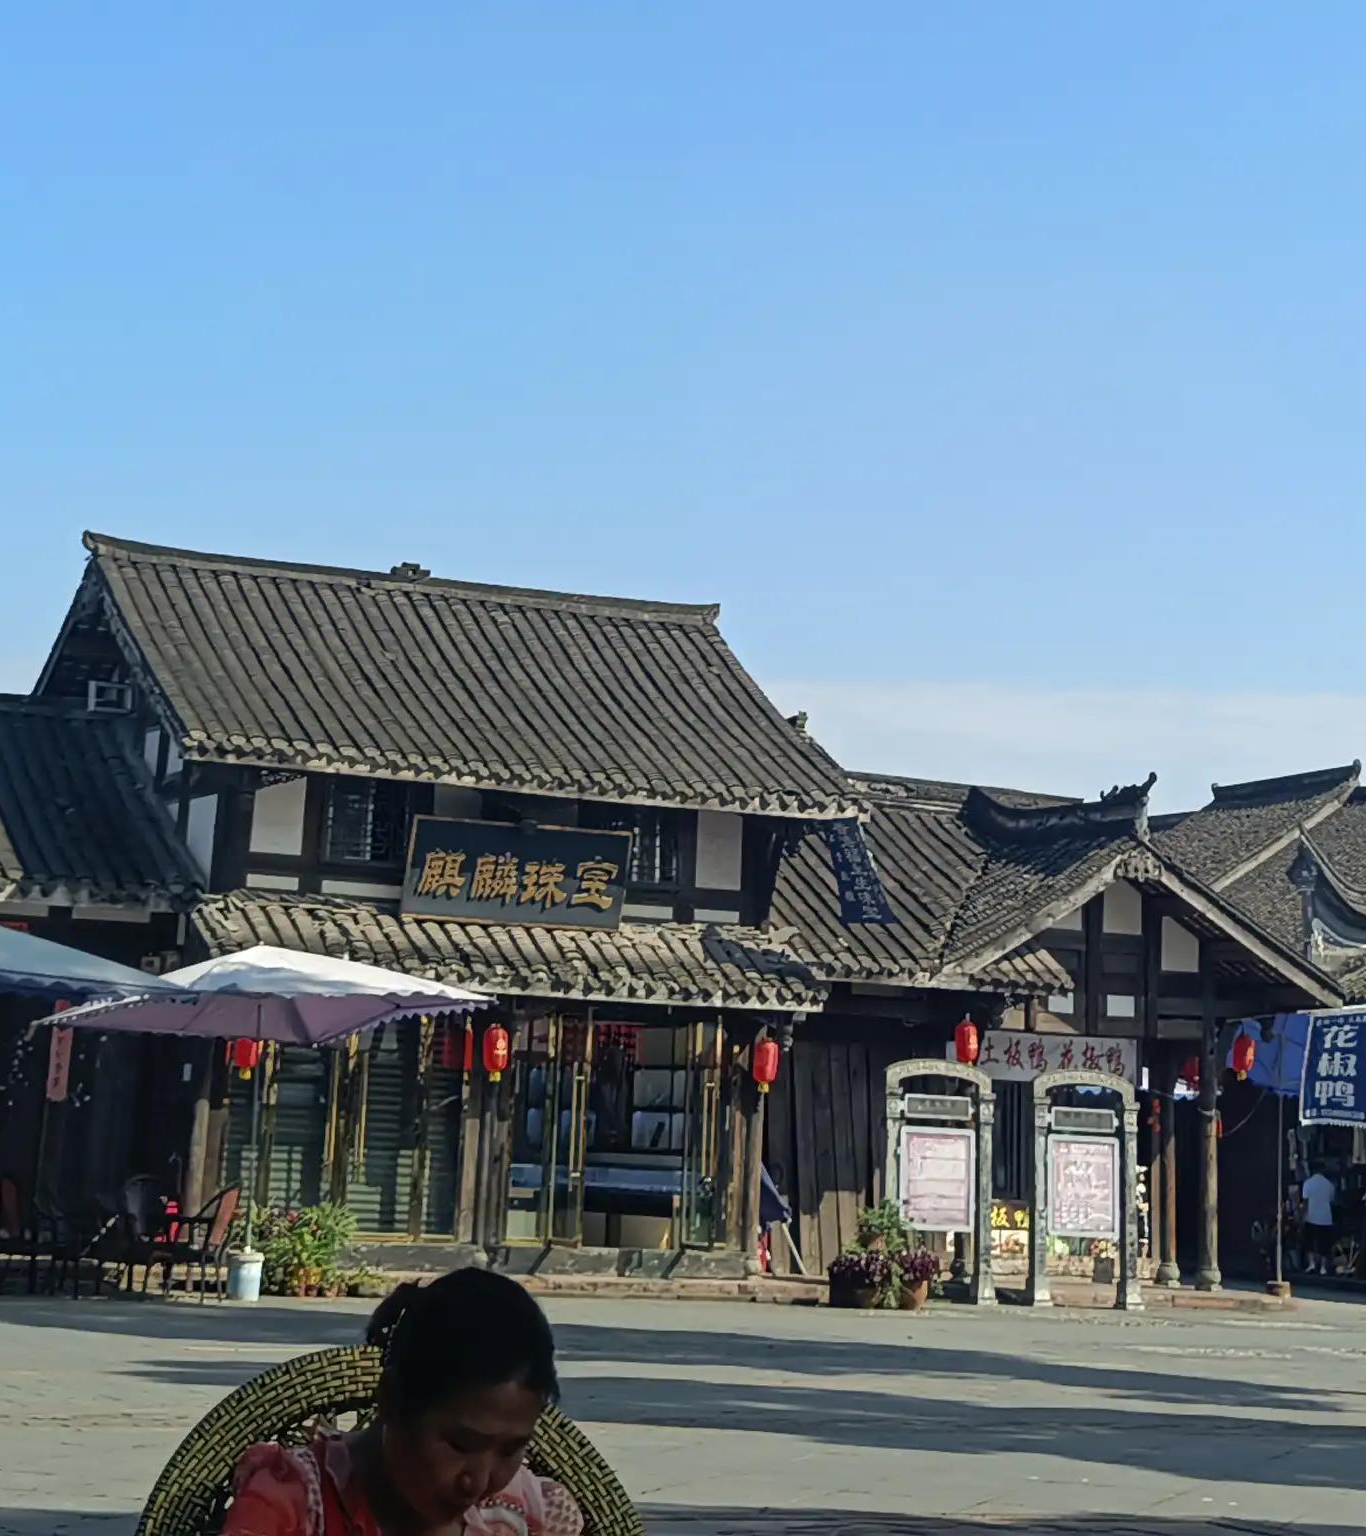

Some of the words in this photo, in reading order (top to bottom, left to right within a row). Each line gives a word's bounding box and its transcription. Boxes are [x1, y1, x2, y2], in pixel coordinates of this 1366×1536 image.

[416, 848, 619, 911] 麒麟珠宝
[1315, 1024, 1359, 1107] 花椒鸭
